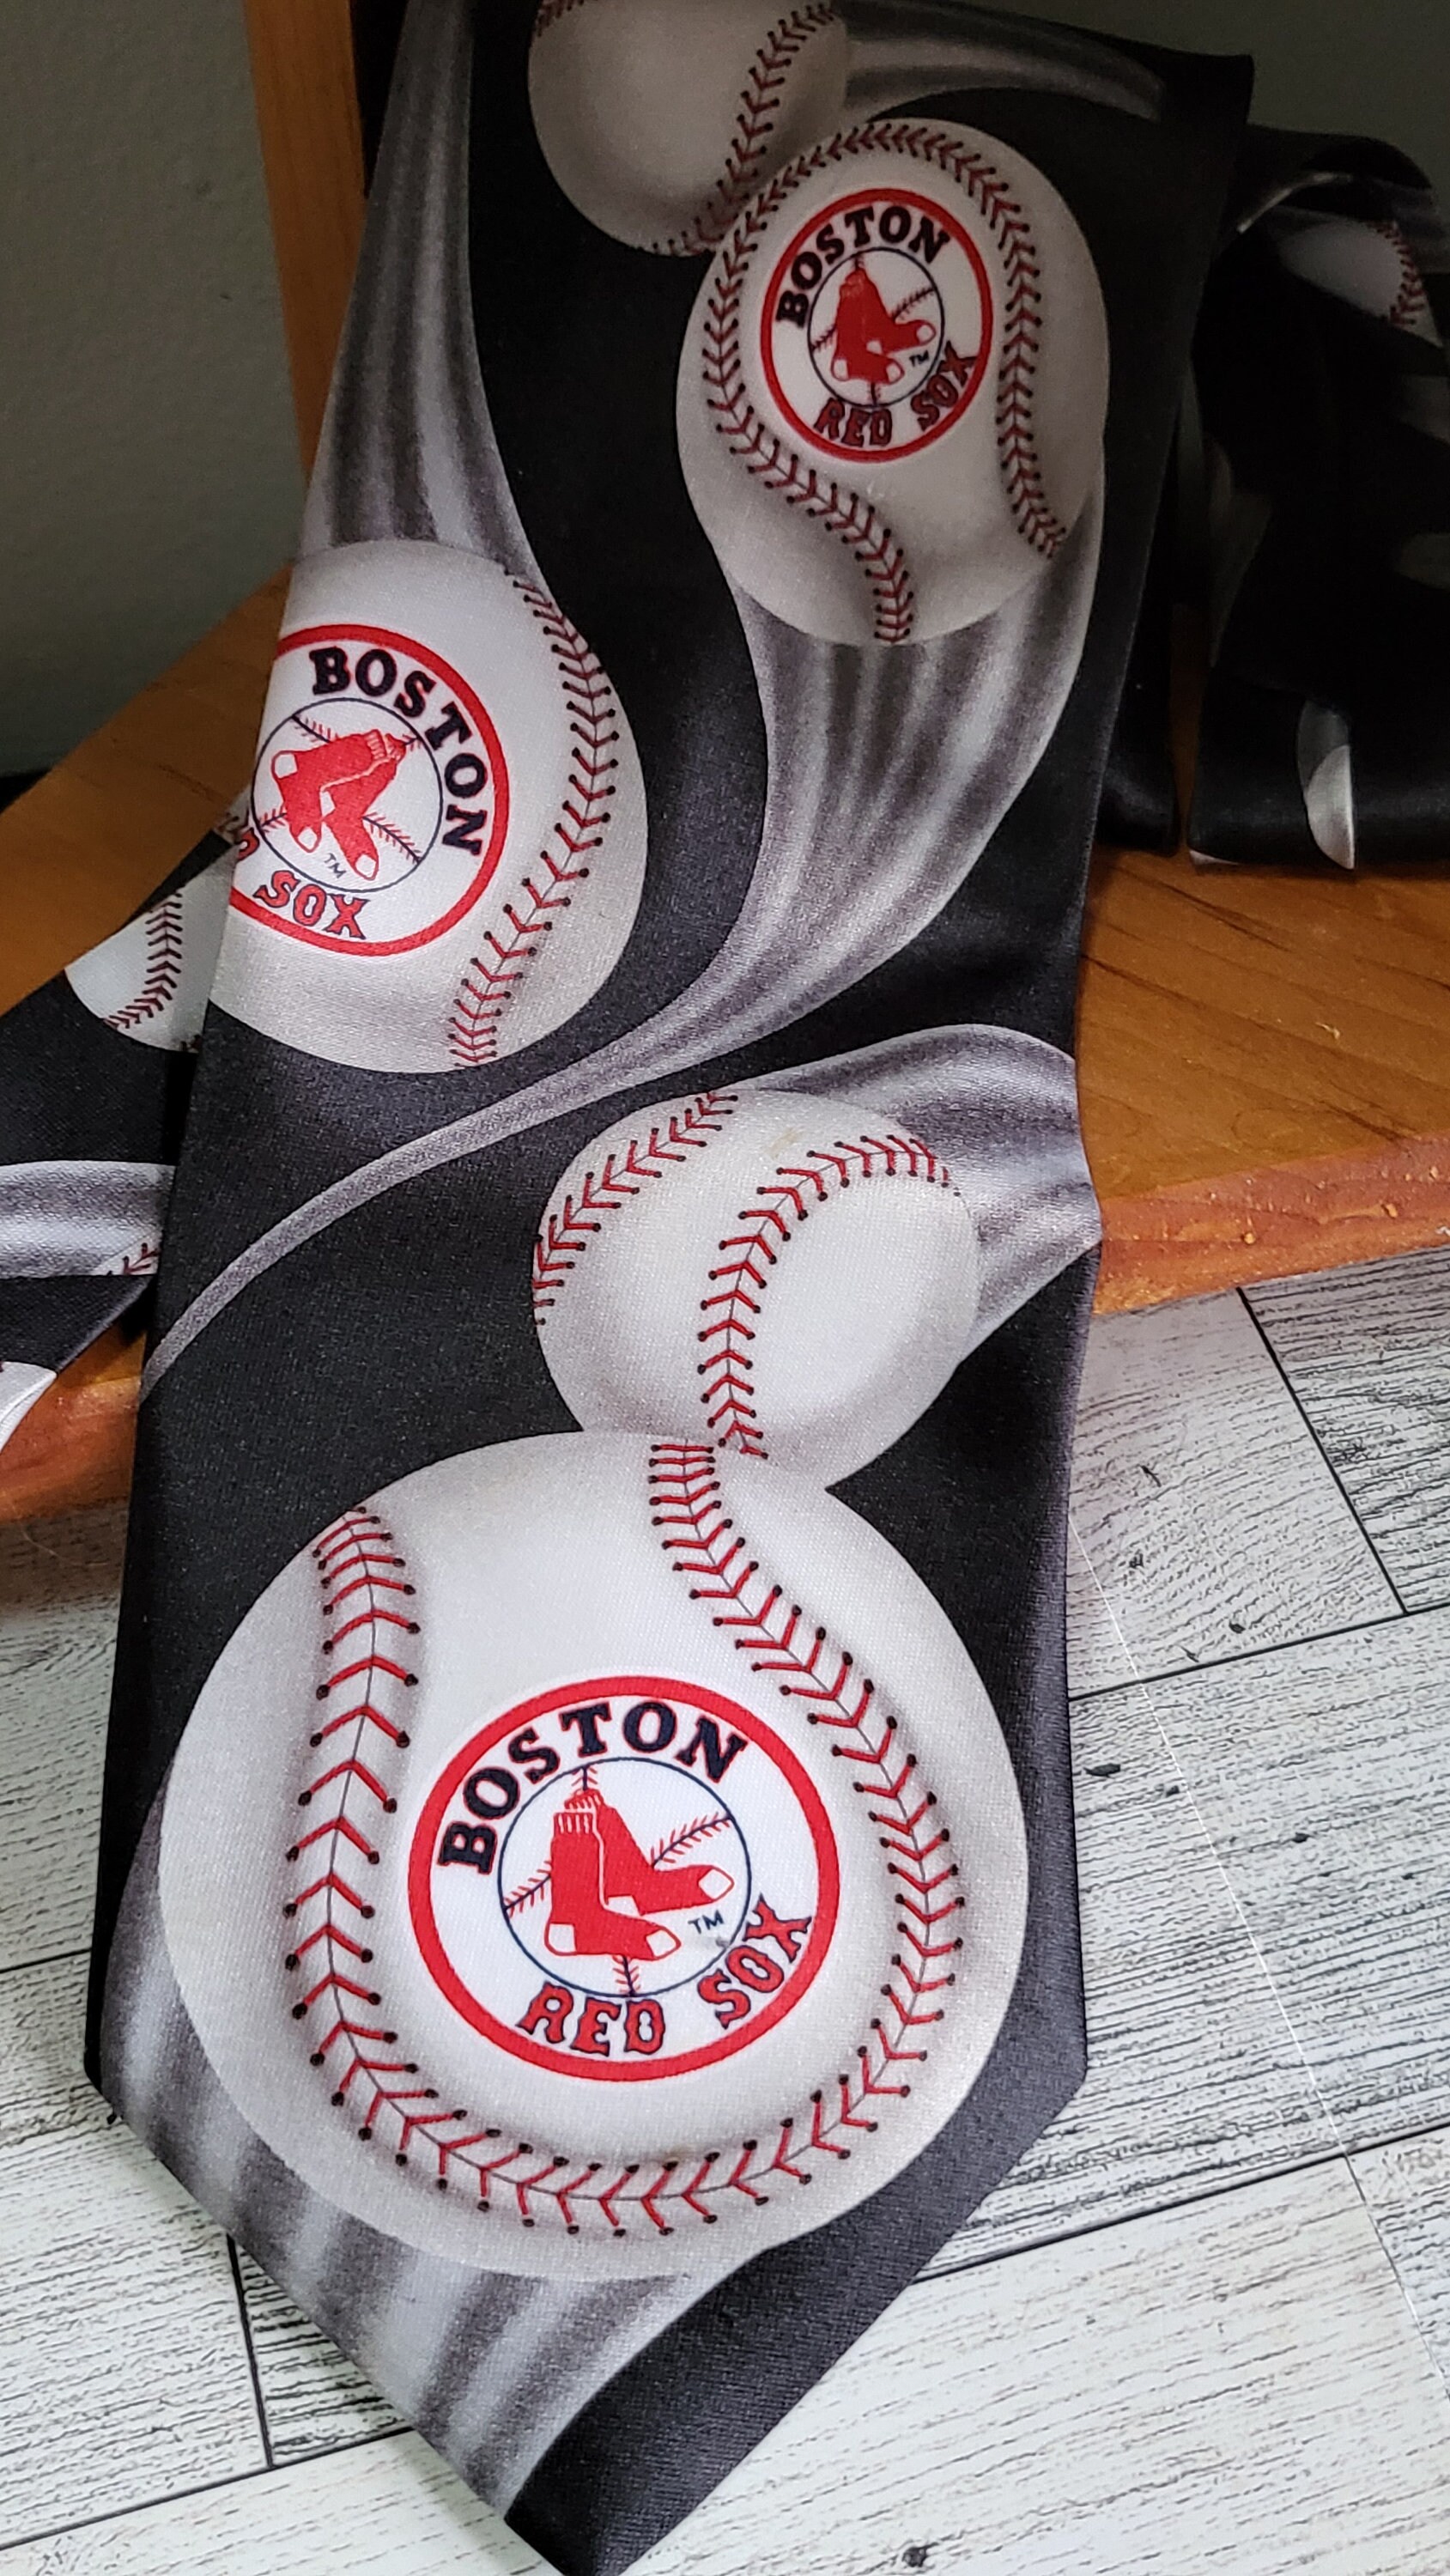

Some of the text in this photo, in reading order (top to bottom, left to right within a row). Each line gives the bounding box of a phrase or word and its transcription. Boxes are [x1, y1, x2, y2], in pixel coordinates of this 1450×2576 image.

[775, 204, 951, 330] BOSTON
[813, 340, 979, 447] RED SOX
[908, 349, 930, 368] TM
[308, 646, 488, 857] BOSTON
[252, 869, 371, 940] SOX
[324, 852, 347, 880] TM
[436, 1701, 749, 1875] BOSTON
[515, 1892, 812, 2057] RED SOX
[687, 1910, 725, 1936] TM
